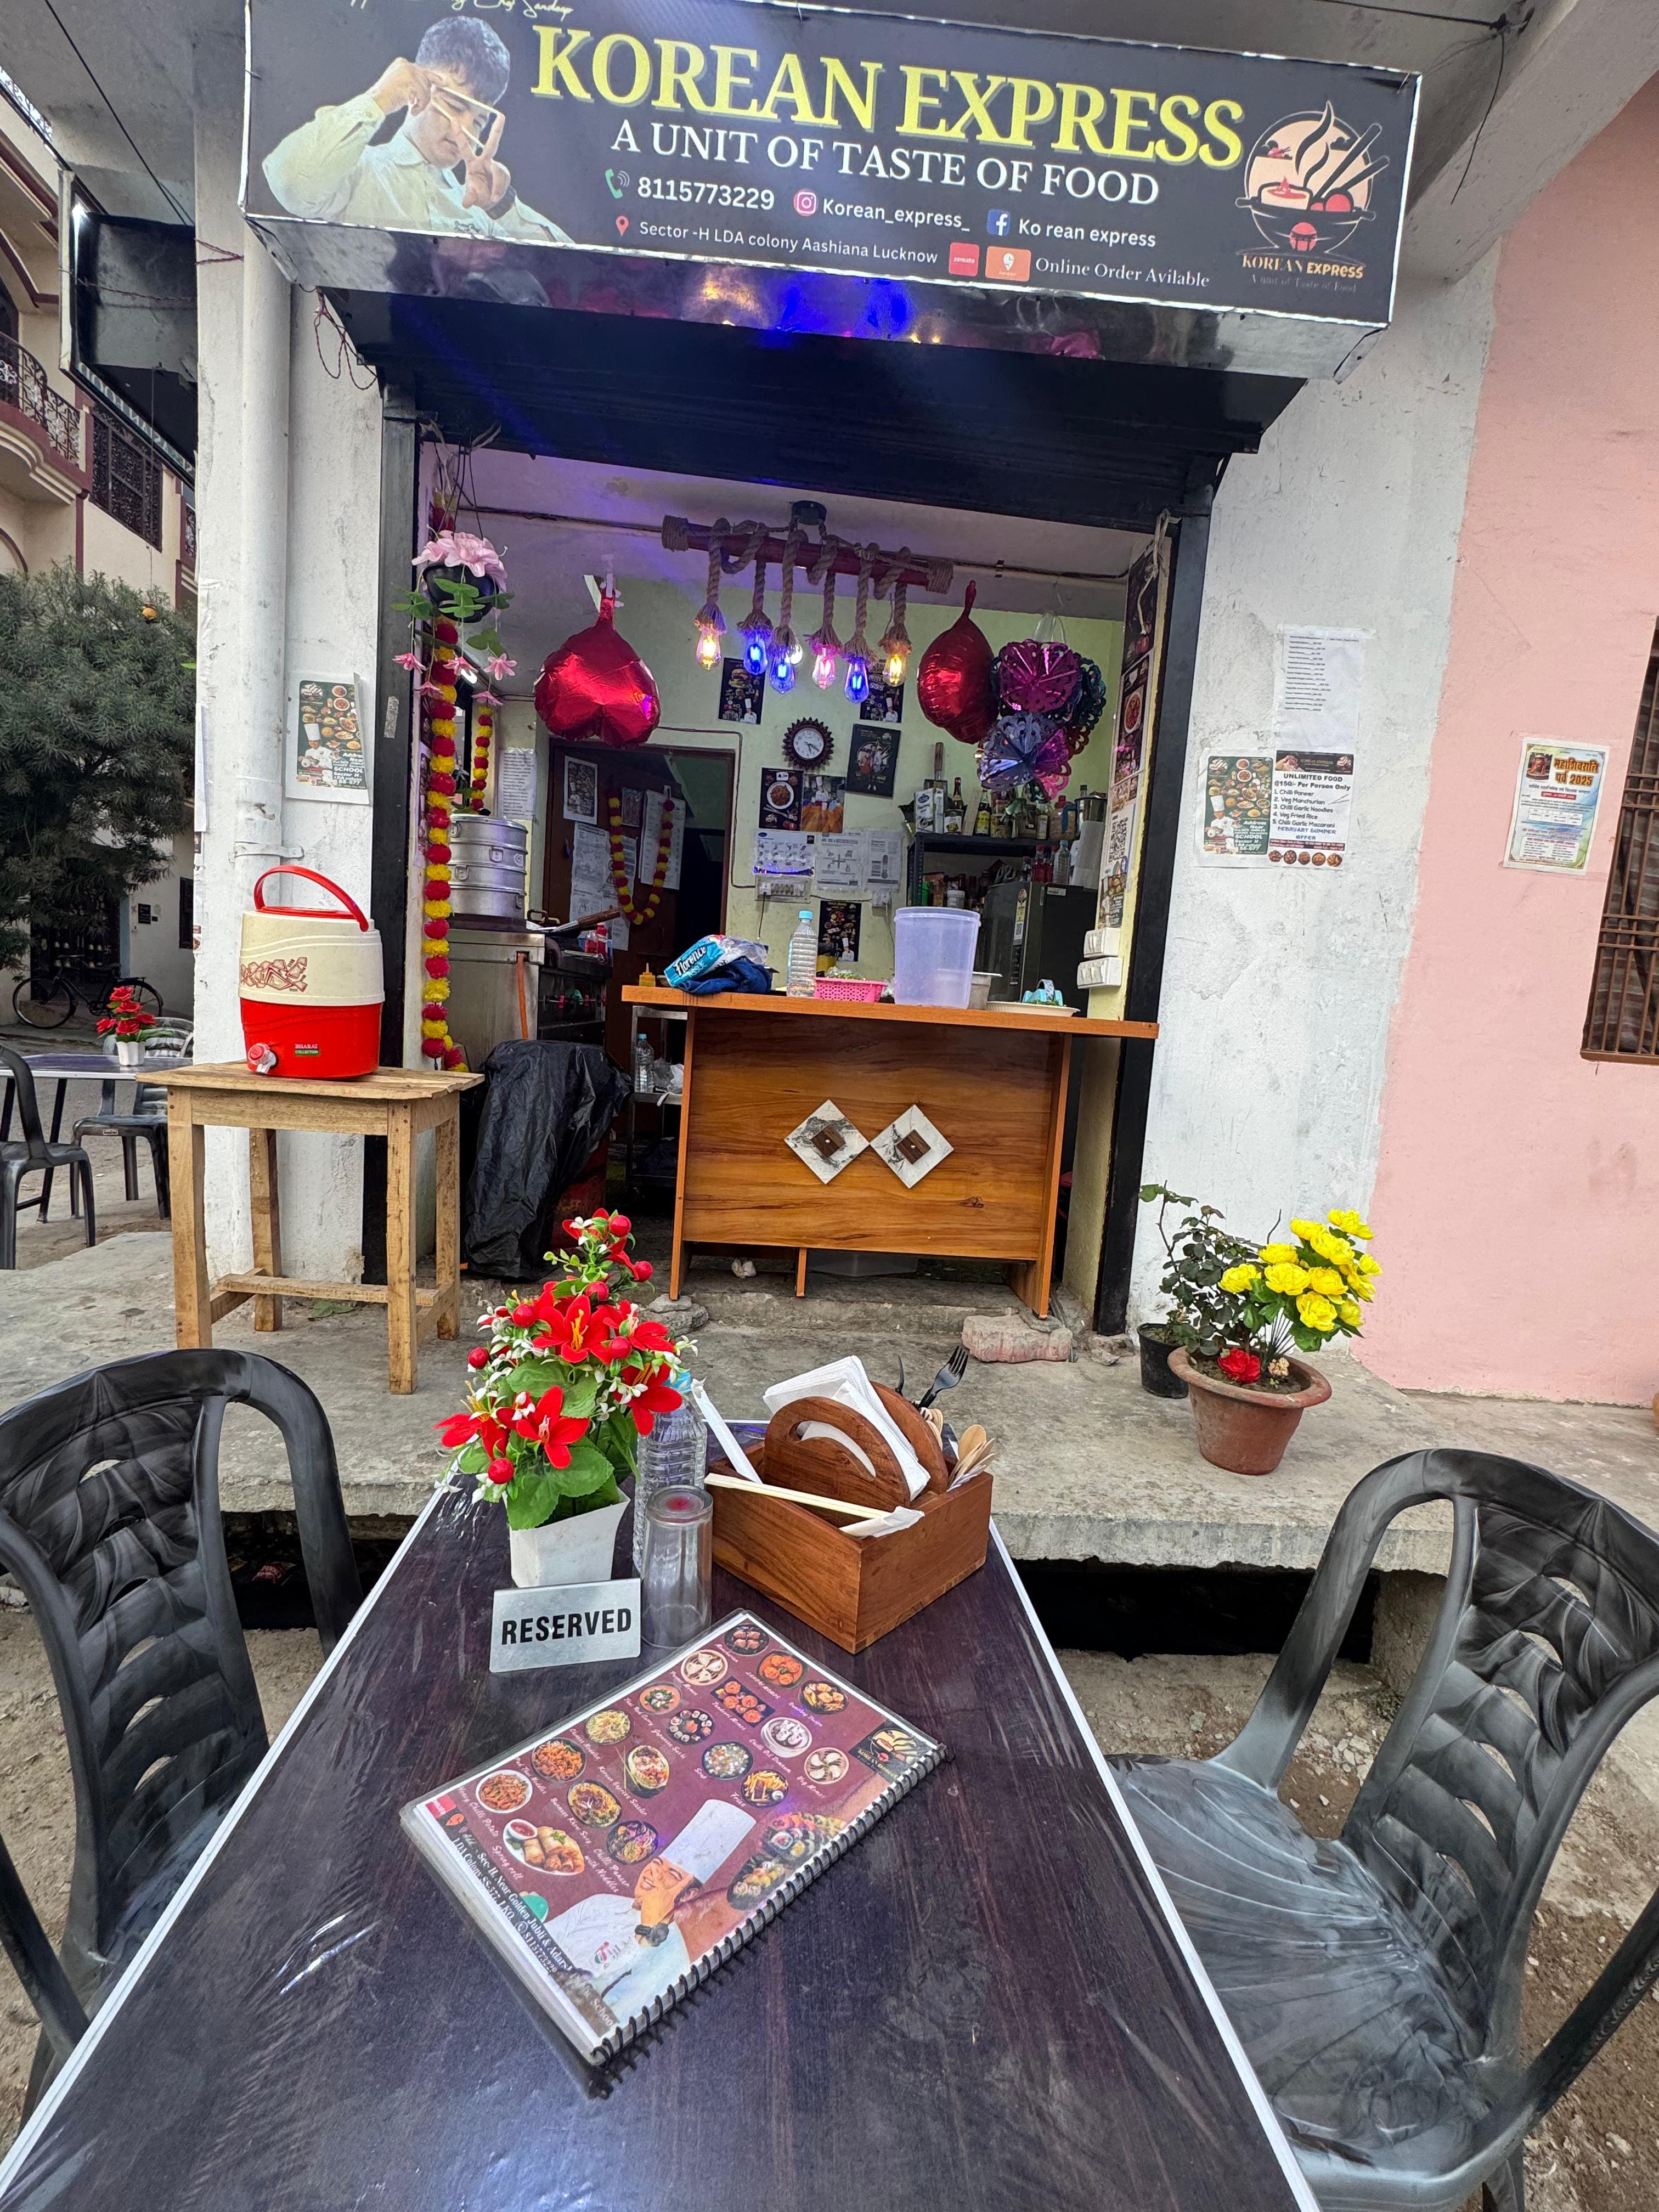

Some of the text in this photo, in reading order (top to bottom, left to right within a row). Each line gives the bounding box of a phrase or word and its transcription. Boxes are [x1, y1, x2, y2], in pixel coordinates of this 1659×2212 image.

[531, 25, 1245, 168] KOREAN EXPRESS
[610, 119, 1159, 205] A UNIT OF TASTE OF FOOD
[637, 177, 775, 210] 8115773229
[640, 221, 689, 240] Sector
[714, 228, 744, 245] LDA
[748, 232, 798, 253] colony
[802, 238, 868, 258] Aashiana
[873, 246, 939, 264] Lucknow
[1018, 218, 1156, 248] Ko rean express
[1035, 257, 1210, 288] Online Order Avilable
[1242, 254, 1304, 273] KOREAN
[1569, 774, 1594, 787] 2025
[674, 946, 707, 977] Florence
[501, 1608, 631, 1645] RESERVED
[482, 1818, 500, 1837] Potato
[492, 1845, 524, 1880] Spring roll
[508, 1892, 531, 1920] Golden
[541, 1937, 552, 1948] &
